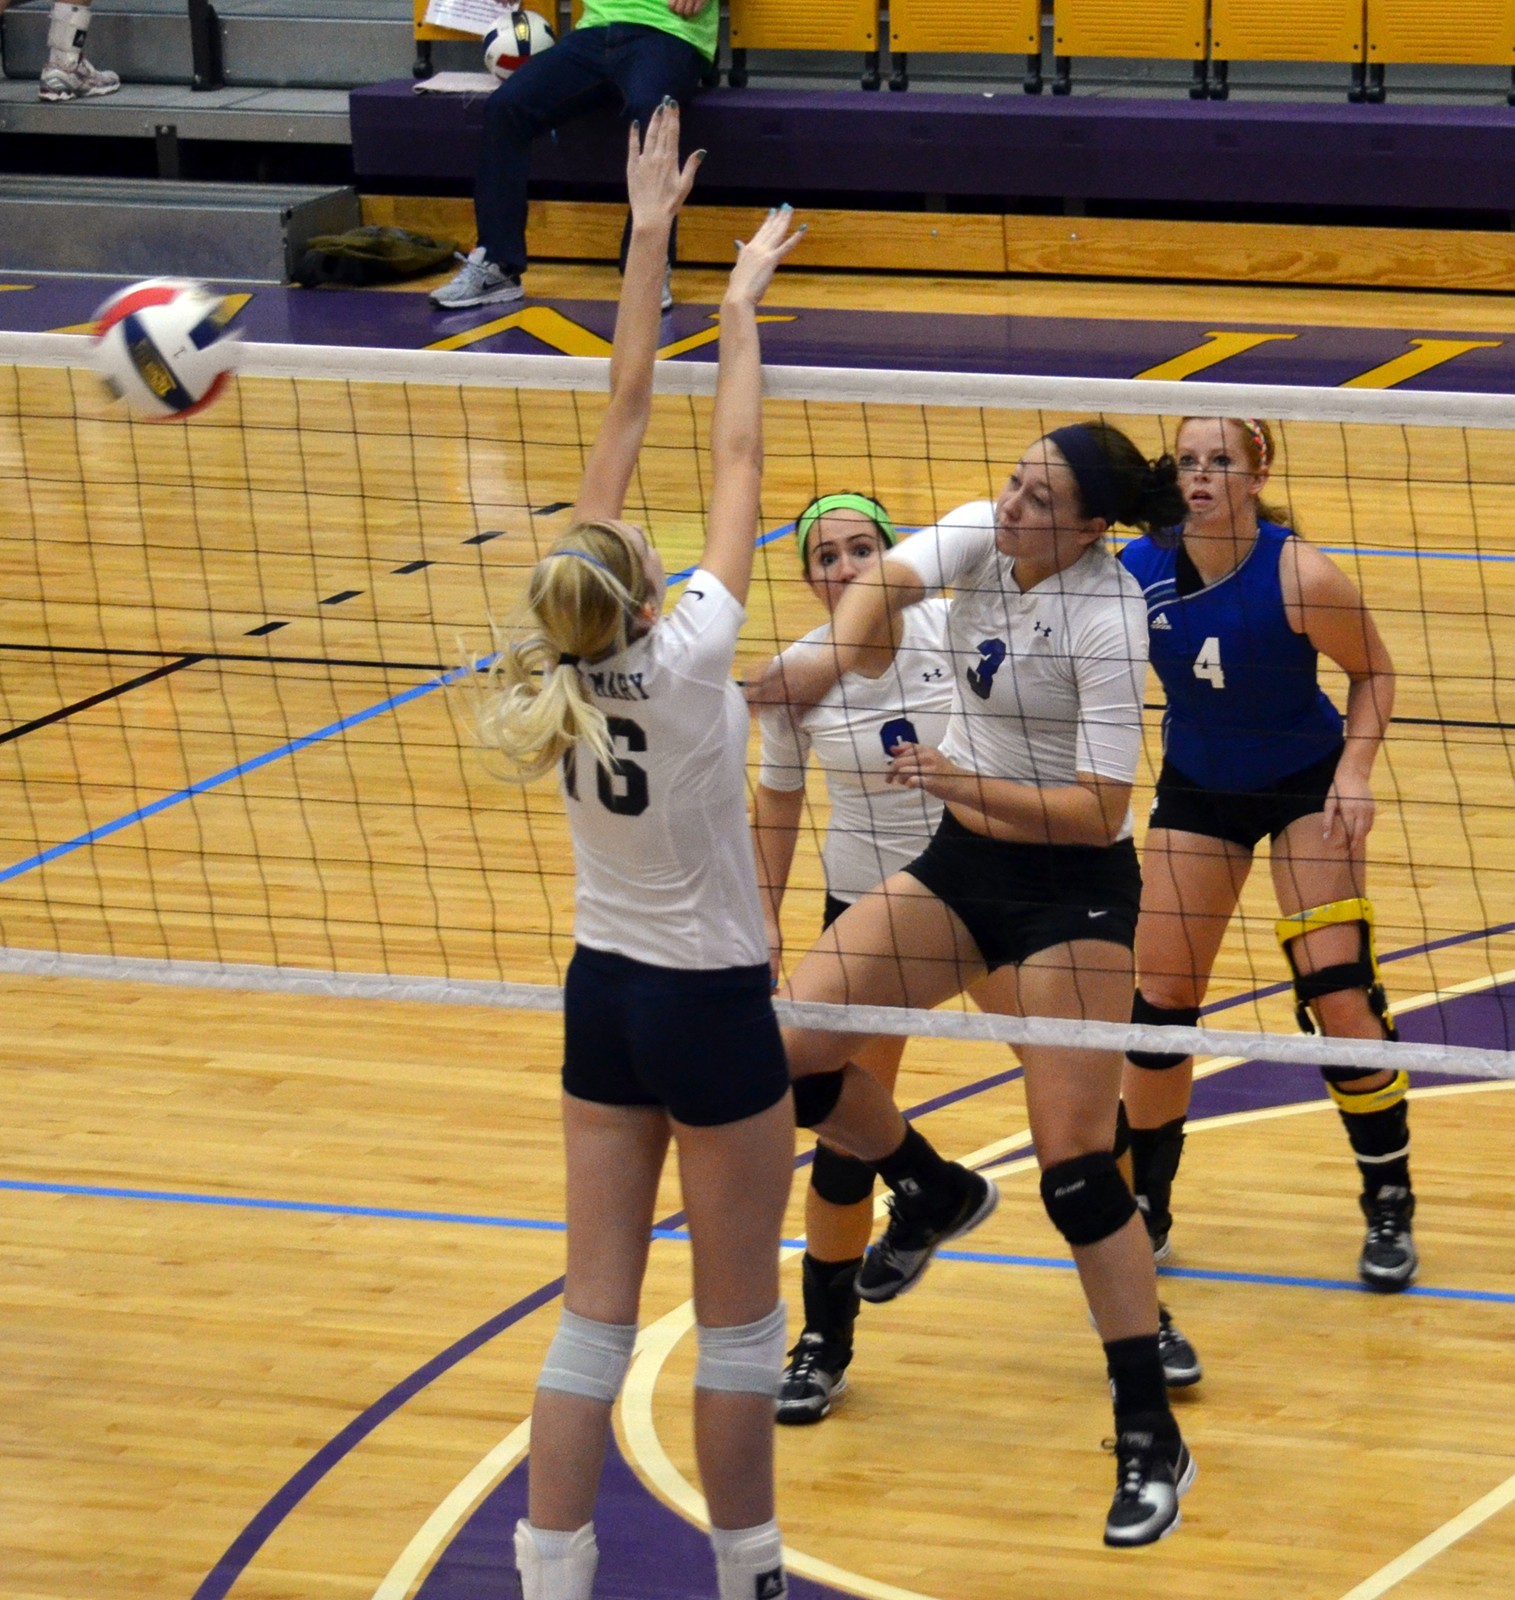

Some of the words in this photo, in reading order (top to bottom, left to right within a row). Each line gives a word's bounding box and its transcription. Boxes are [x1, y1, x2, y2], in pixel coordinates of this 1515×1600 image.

[589, 671, 650, 700] MARY
[966, 638, 1006, 699] 3
[1193, 637, 1225, 689] 4
